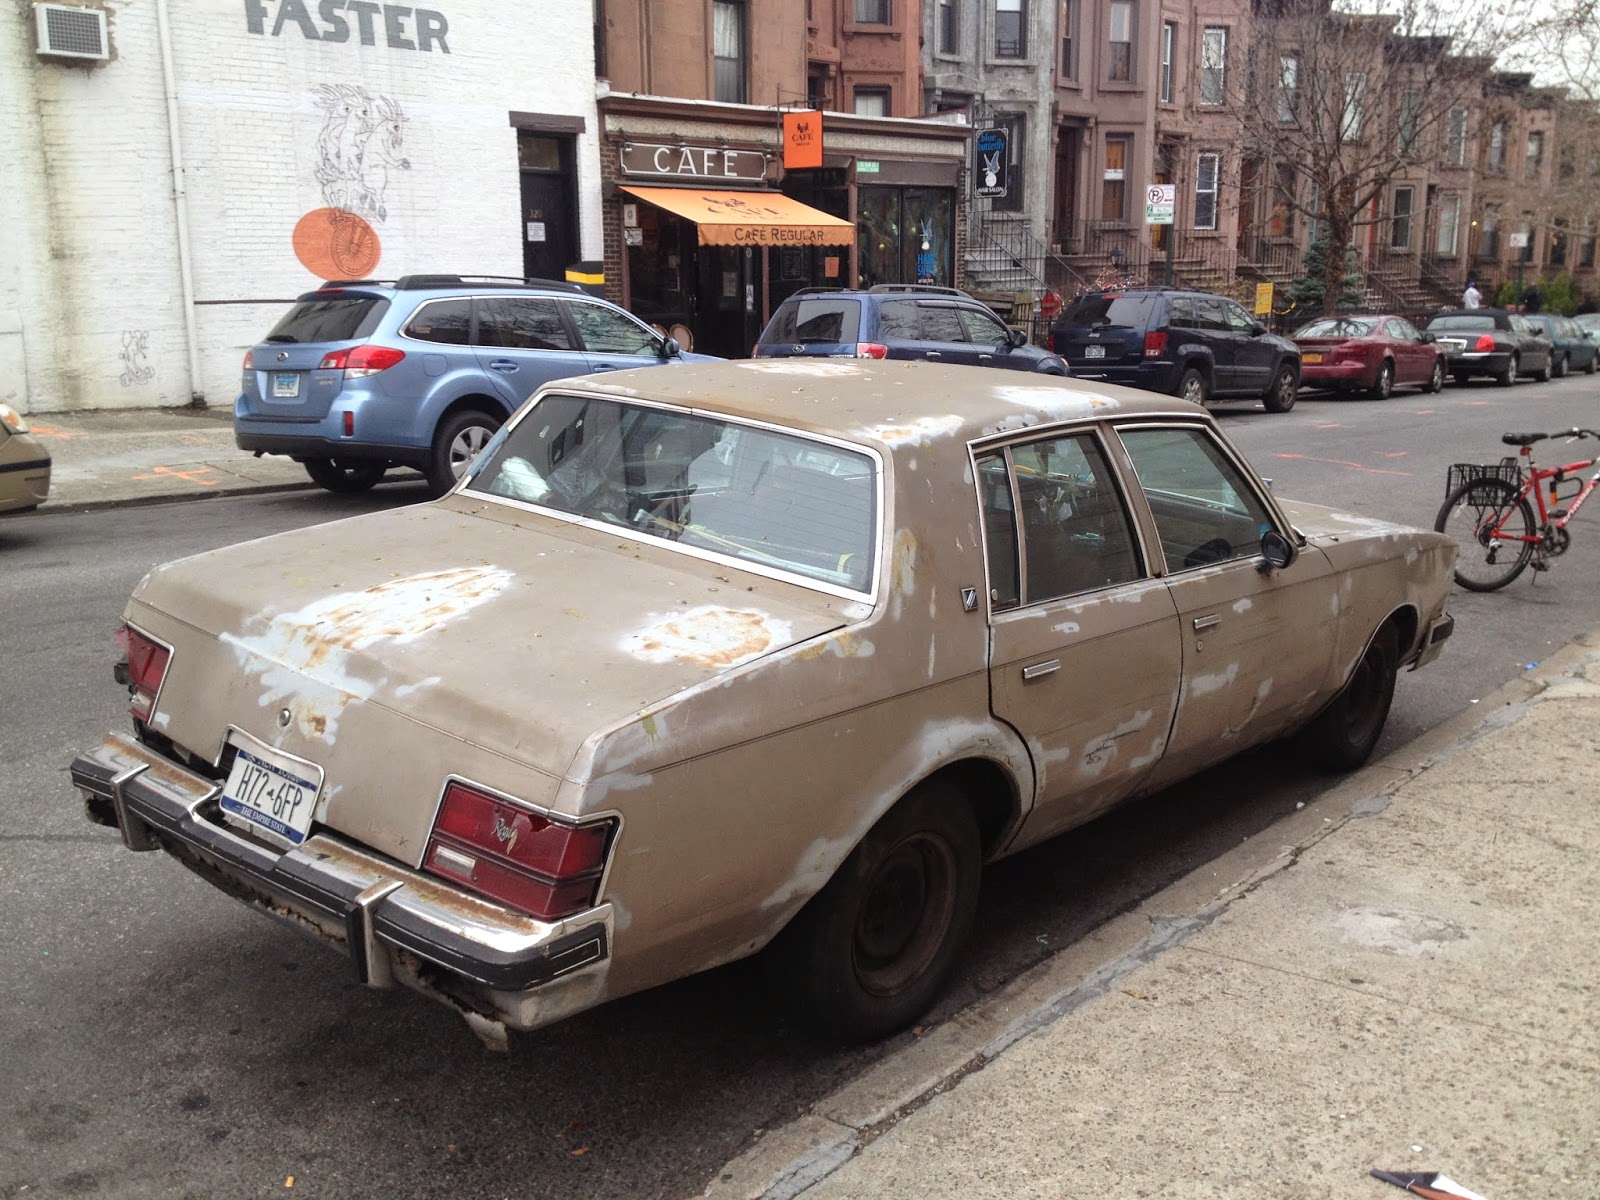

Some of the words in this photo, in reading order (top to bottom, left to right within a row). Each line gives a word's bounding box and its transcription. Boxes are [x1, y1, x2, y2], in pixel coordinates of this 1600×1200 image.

[245, 0, 451, 54] FASTER
[771, 228, 824, 241] REGULAR
[240, 805, 252, 817] THE
[252, 810, 271, 827] EMPIRE
[270, 820, 286, 834] STATE
